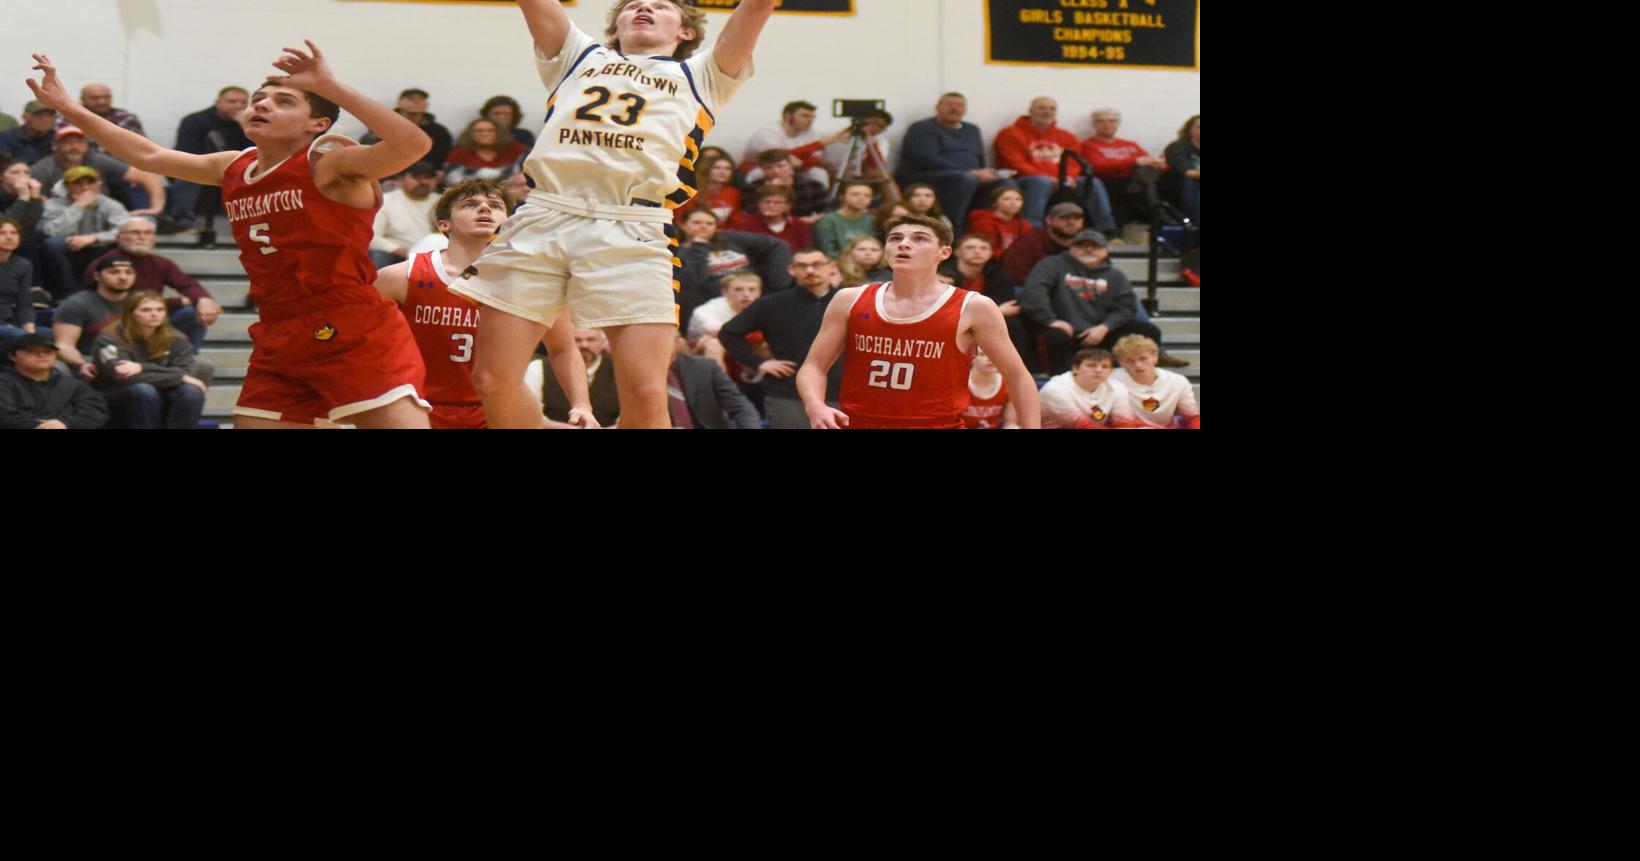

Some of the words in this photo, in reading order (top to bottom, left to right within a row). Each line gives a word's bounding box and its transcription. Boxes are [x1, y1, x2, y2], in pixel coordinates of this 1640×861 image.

[1019, 9, 1063, 24] GIRLS
[1074, 10, 1165, 28] BASKETBALL
[1053, 27, 1132, 43] CHAMPIONS
[1062, 45, 1125, 60] 1994-95
[574, 85, 646, 128] 23
[559, 128, 645, 151] PANTHERS
[249, 223, 278, 255] 5
[449, 333, 474, 363] 3
[868, 359, 915, 390] 20
